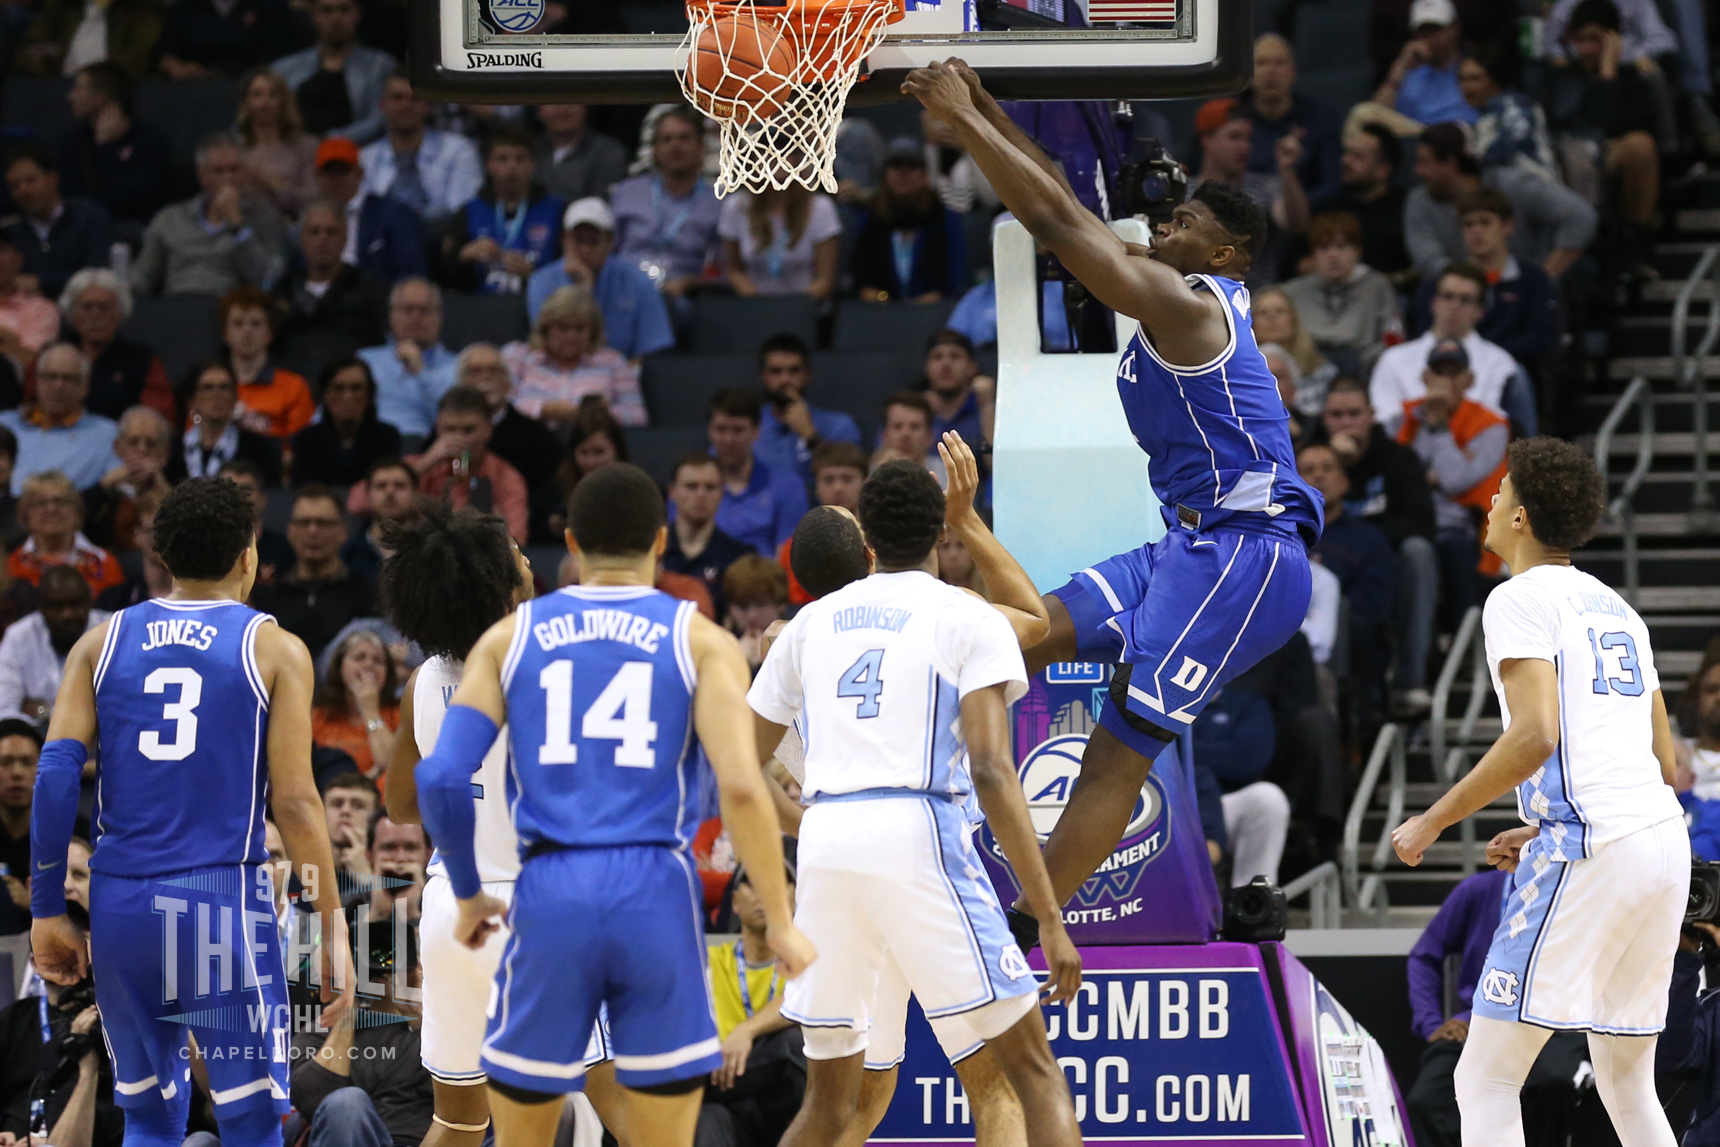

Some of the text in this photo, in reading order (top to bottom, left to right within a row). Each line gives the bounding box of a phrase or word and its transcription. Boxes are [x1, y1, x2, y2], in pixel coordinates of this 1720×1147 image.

[467, 51, 542, 69] SPALDING
[141, 619, 218, 651] JONES
[533, 608, 669, 654] GOLDWIRE
[832, 605, 913, 634] ROBINSON
[1058, 661, 1094, 675] LIFE
[1587, 627, 1645, 697] 13
[837, 648, 885, 719] 4
[138, 667, 203, 761] 3
[538, 658, 658, 769] 14
[1094, 831, 1160, 873] AMENT
[1060, 897, 1143, 925] LOTTE, NC
